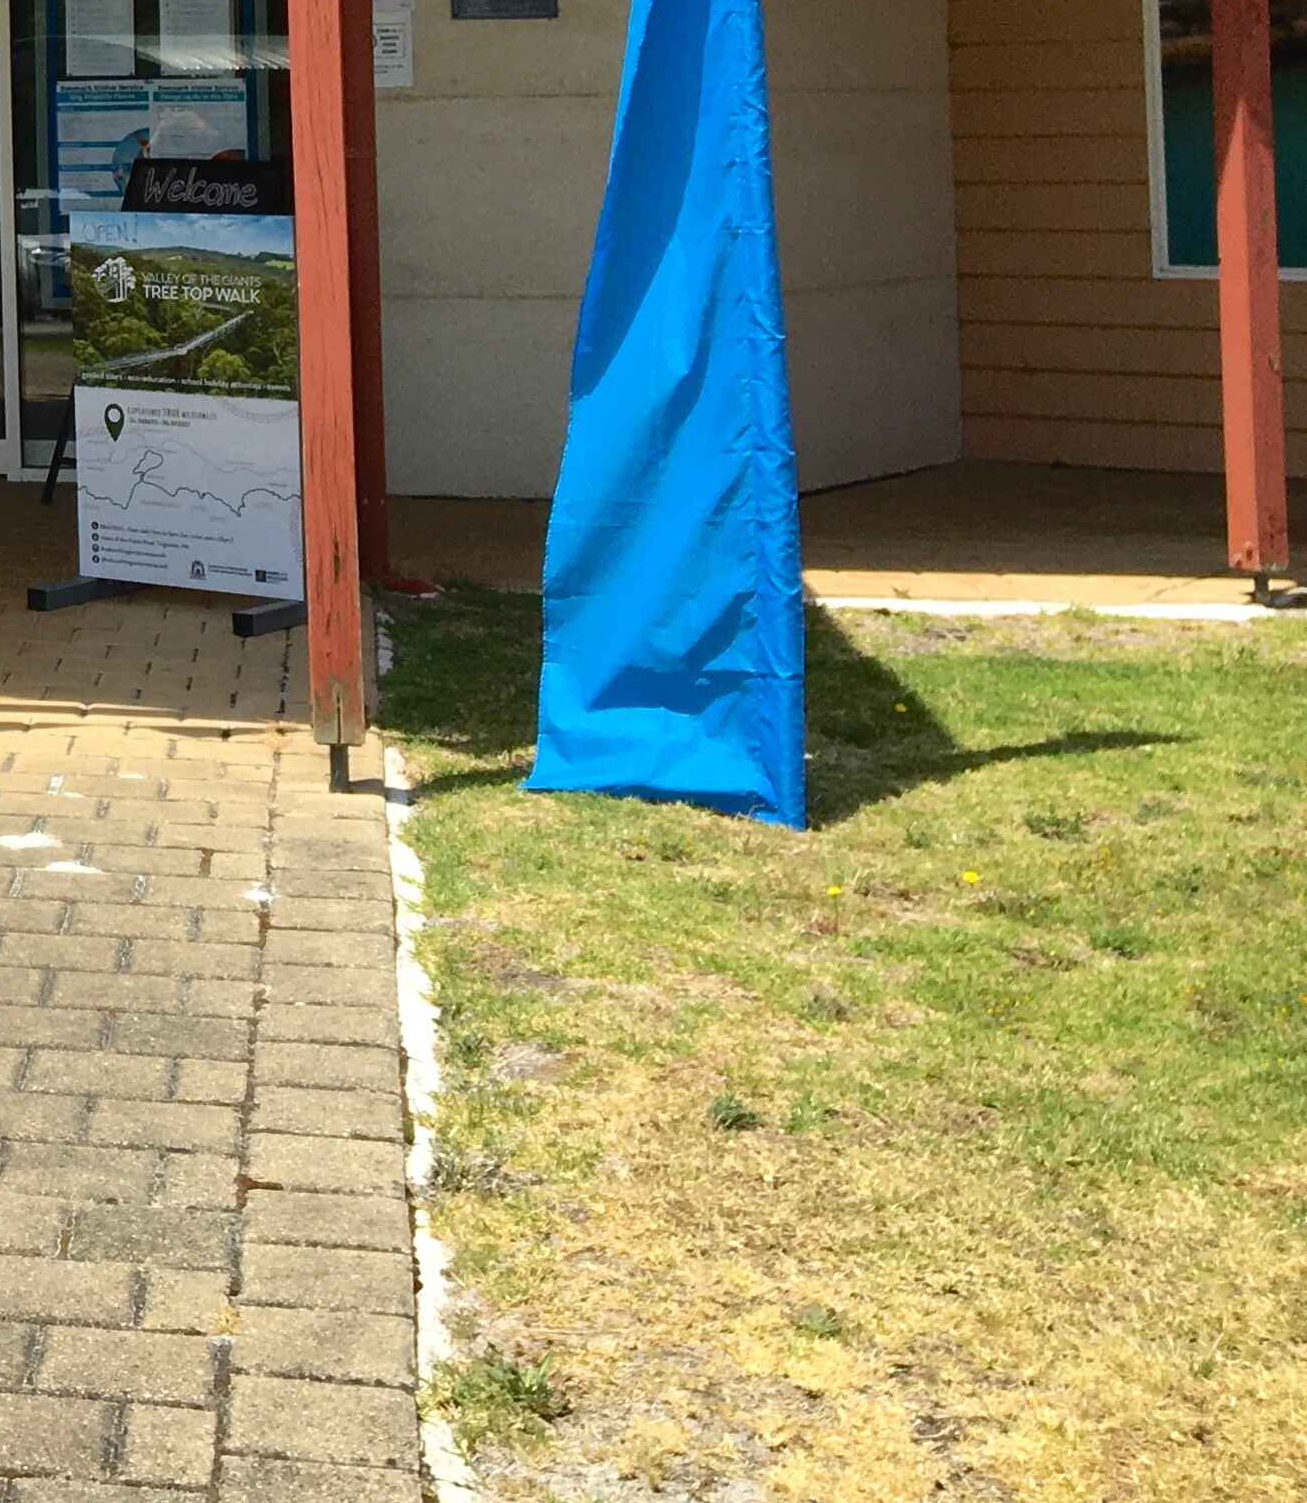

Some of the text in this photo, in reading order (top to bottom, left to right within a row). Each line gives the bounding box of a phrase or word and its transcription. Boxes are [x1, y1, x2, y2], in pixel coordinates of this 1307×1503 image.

[143, 166, 259, 208] Welcome
[82, 213, 138, 244] OPEN!
[142, 273, 262, 287] VALLEY OF THE GIANTS
[142, 284, 262, 304] TREE TOP WALK
